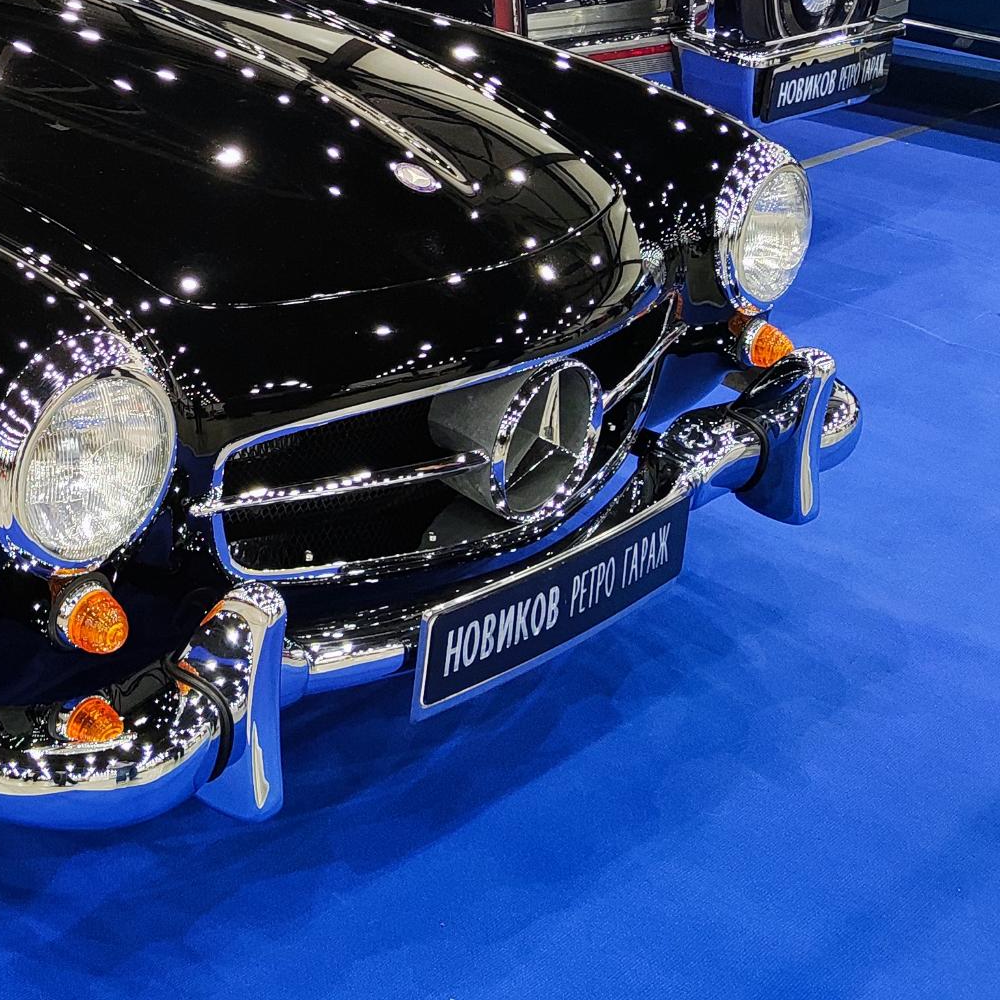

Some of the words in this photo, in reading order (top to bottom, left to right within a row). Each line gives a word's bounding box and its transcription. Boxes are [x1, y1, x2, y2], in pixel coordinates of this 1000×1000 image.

[776, 68, 838, 108] НОВИКОВ
[837, 62, 861, 92] РЕТРО
[861, 52, 887, 84] ГАРАЖ
[443, 585, 560, 677] НОВИКОВ
[569, 556, 616, 618] РЕТРО
[621, 522, 671, 589] ГАРАЖ
